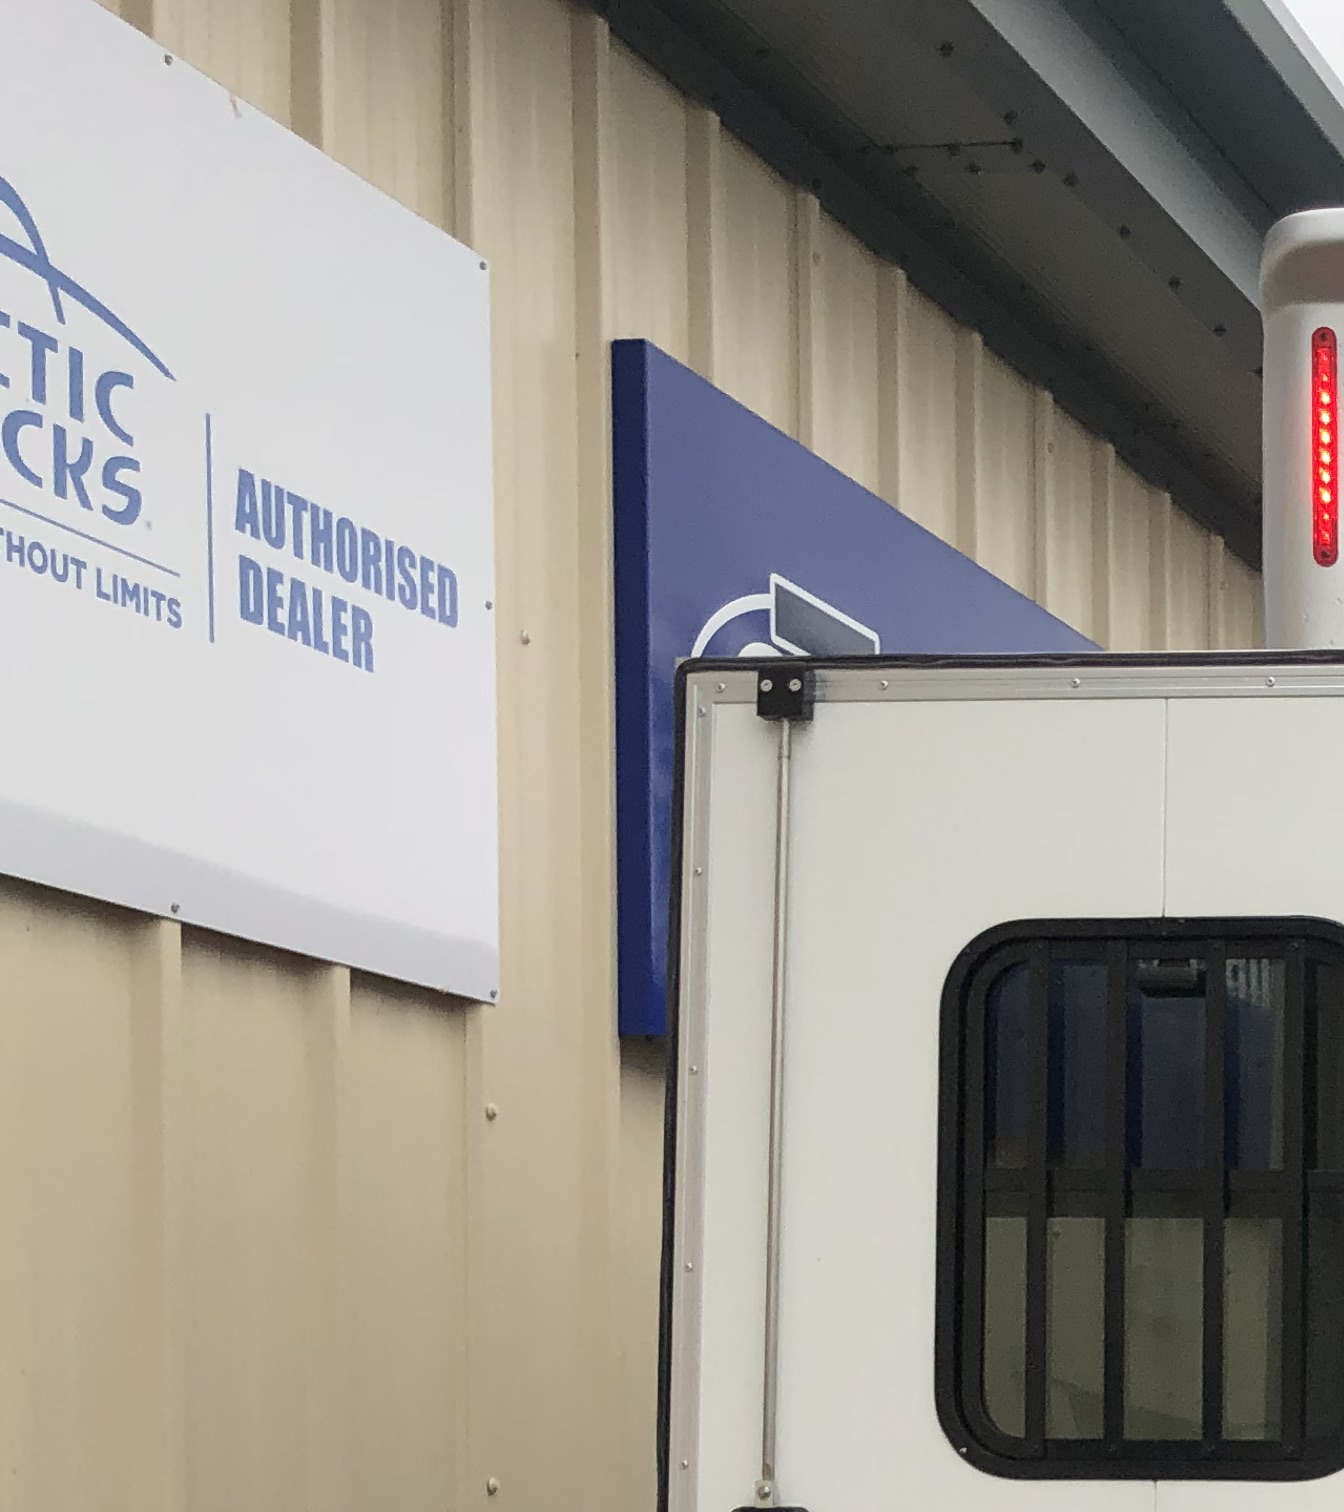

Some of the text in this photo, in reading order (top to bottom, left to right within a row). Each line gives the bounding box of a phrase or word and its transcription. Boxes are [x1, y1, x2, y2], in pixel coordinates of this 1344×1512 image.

[0, 527, 183, 629] HOUT LIMITS
[235, 467, 460, 628] AUTHORISED
[238, 554, 375, 673] DEALER
